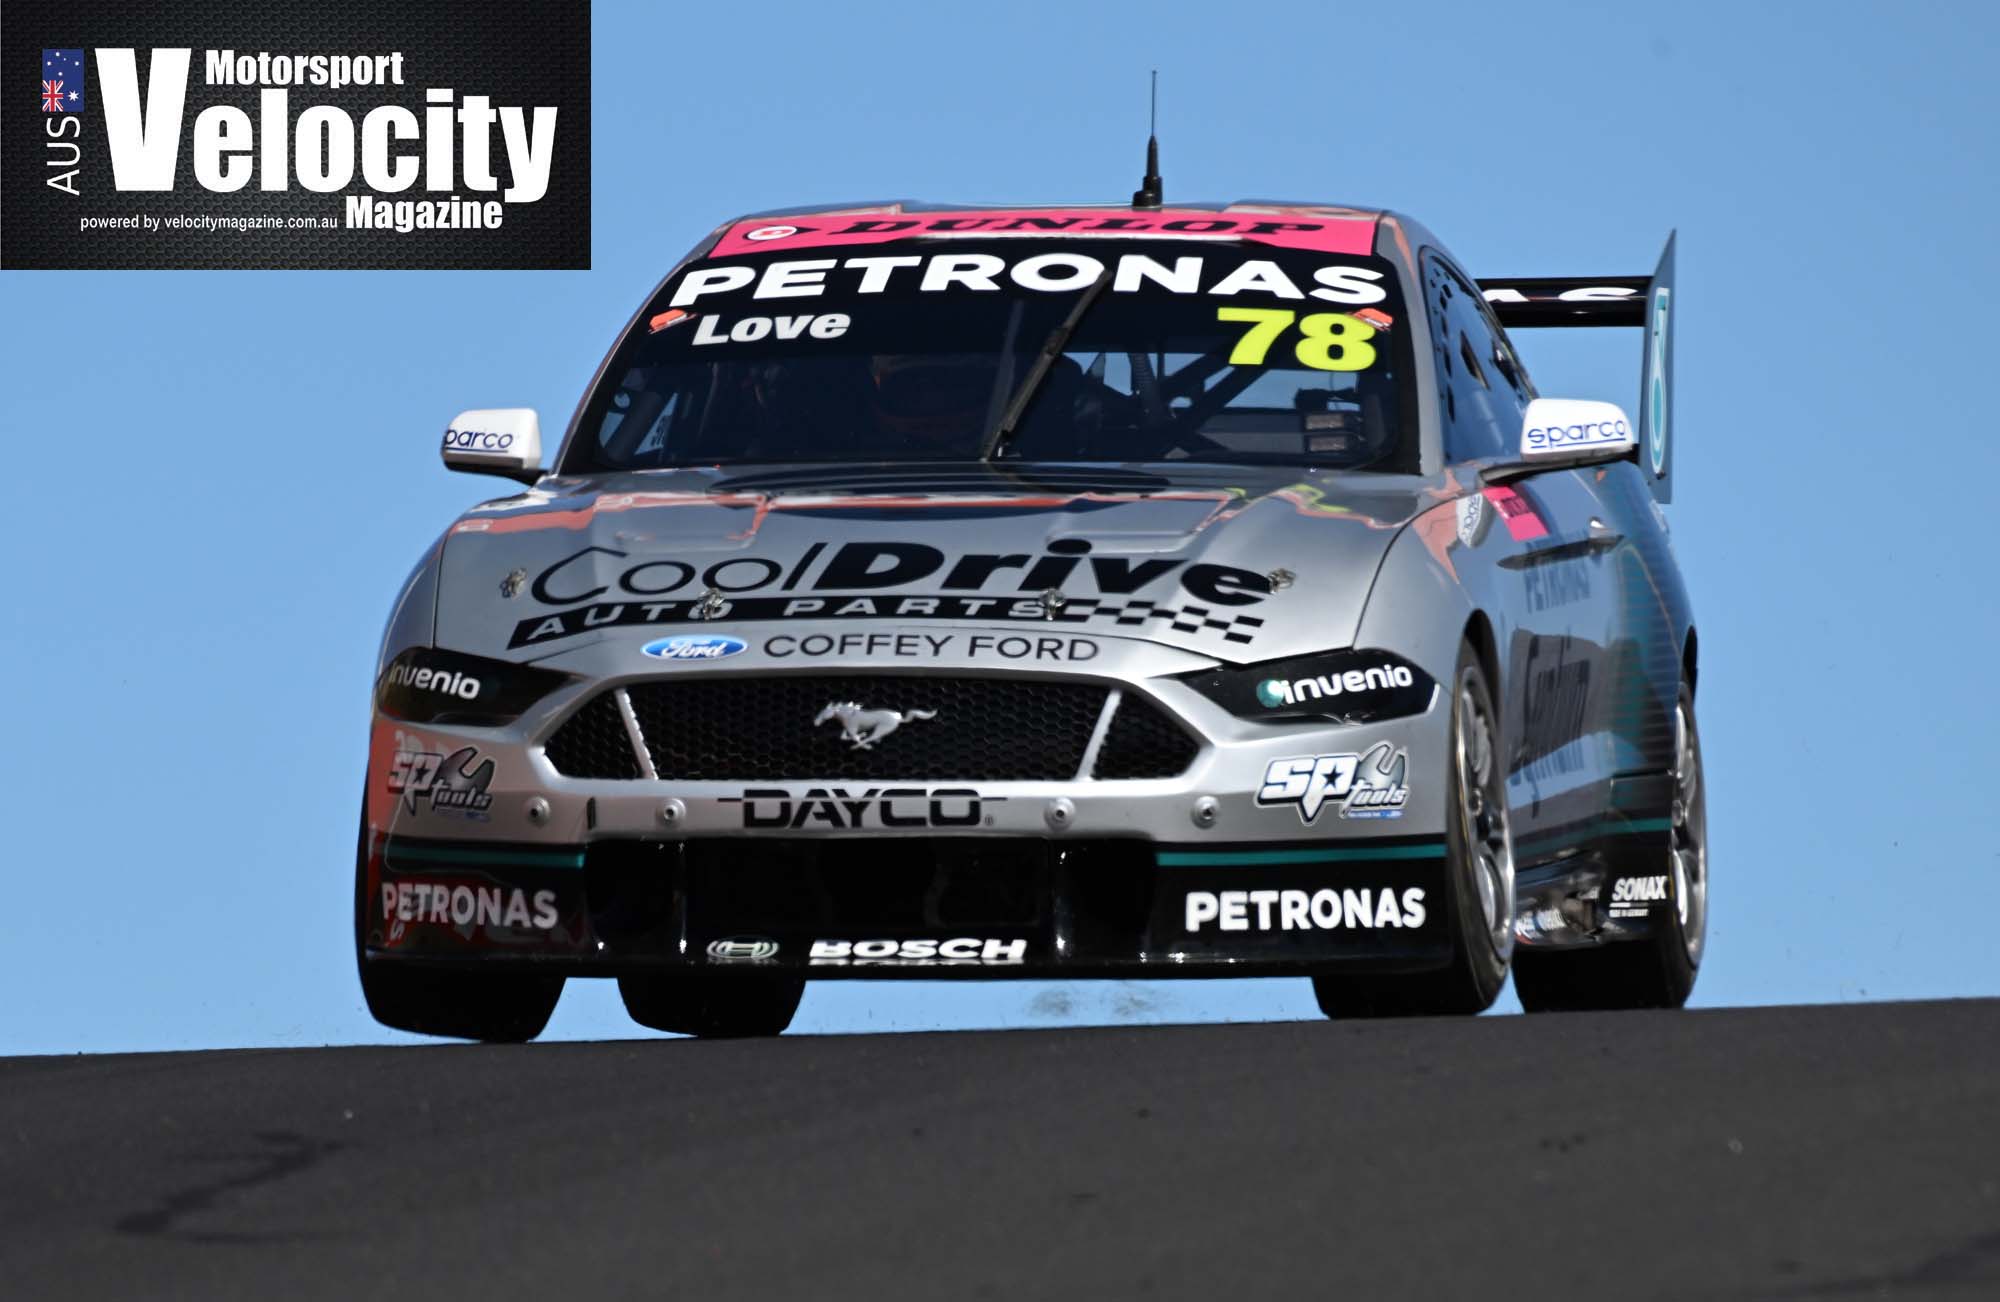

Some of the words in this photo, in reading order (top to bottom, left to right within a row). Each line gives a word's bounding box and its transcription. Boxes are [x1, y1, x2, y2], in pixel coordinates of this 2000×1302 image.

[827, 216, 1324, 235] DUNLOP
[669, 252, 1387, 307] PETRONAS
[692, 312, 851, 346] Love
[1217, 306, 1377, 372] 78
[1527, 419, 1626, 450] sparco
[531, 537, 1273, 606] CoolDrive
[527, 601, 731, 641] AUTO
[786, 595, 1057, 619] PARTS
[660, 638, 728, 658] Ford
[764, 633, 952, 658] COFFEY
[967, 635, 1099, 661] FORD
[1281, 663, 1413, 704] invenio
[743, 788, 982, 828] DAYCO
[1257, 754, 1360, 823] SP
[381, 882, 559, 929] PETRONAS
[1612, 876, 1668, 901] SONAX
[1185, 887, 1426, 932] PETRONAS
[809, 938, 1028, 959] BOSCH
